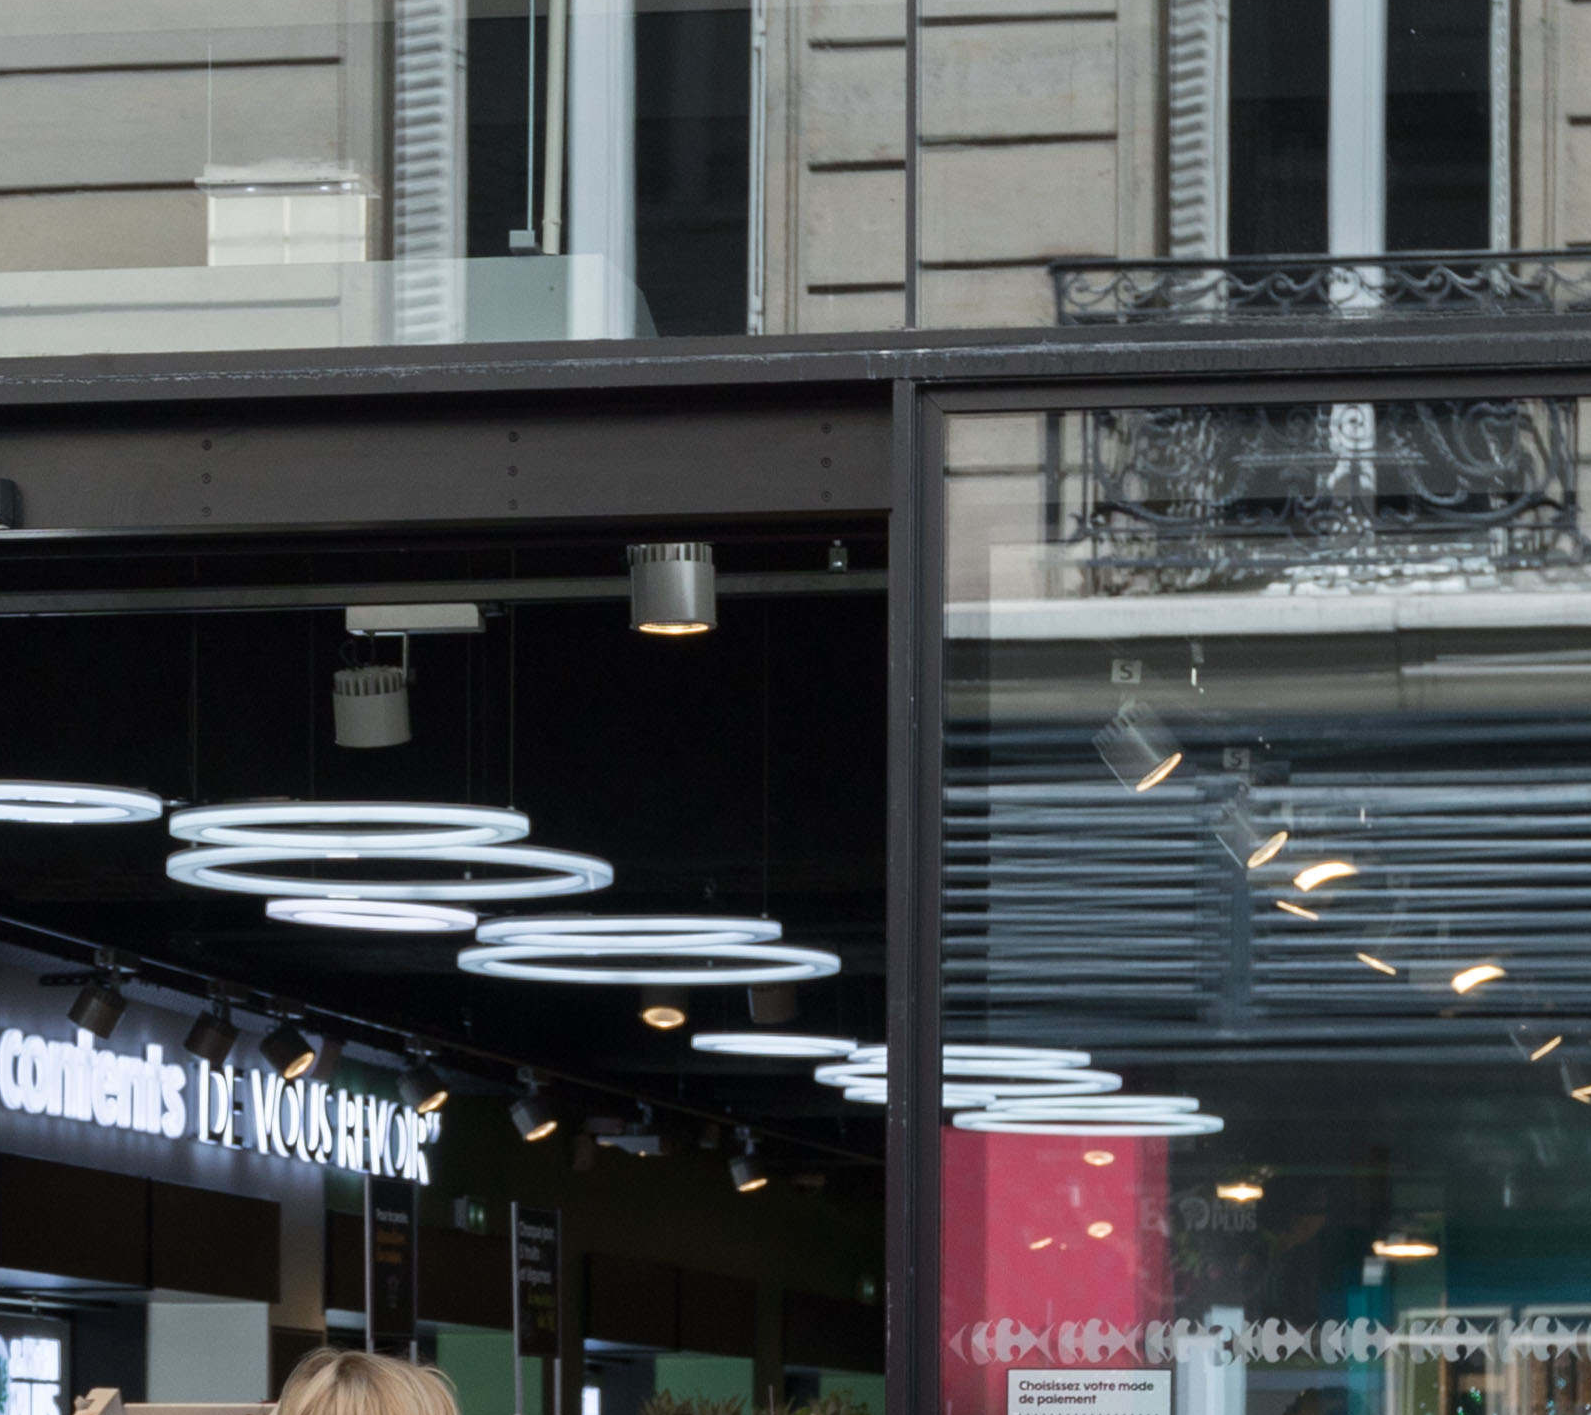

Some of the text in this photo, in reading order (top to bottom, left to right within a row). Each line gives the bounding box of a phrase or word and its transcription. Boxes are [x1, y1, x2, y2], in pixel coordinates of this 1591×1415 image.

[199, 1058, 244, 1150] DE
[251, 1068, 333, 1164] VOUS
[1019, 1380, 1155, 1392] Choisissez votre mode
[1019, 1394, 1097, 1407] de paiement
